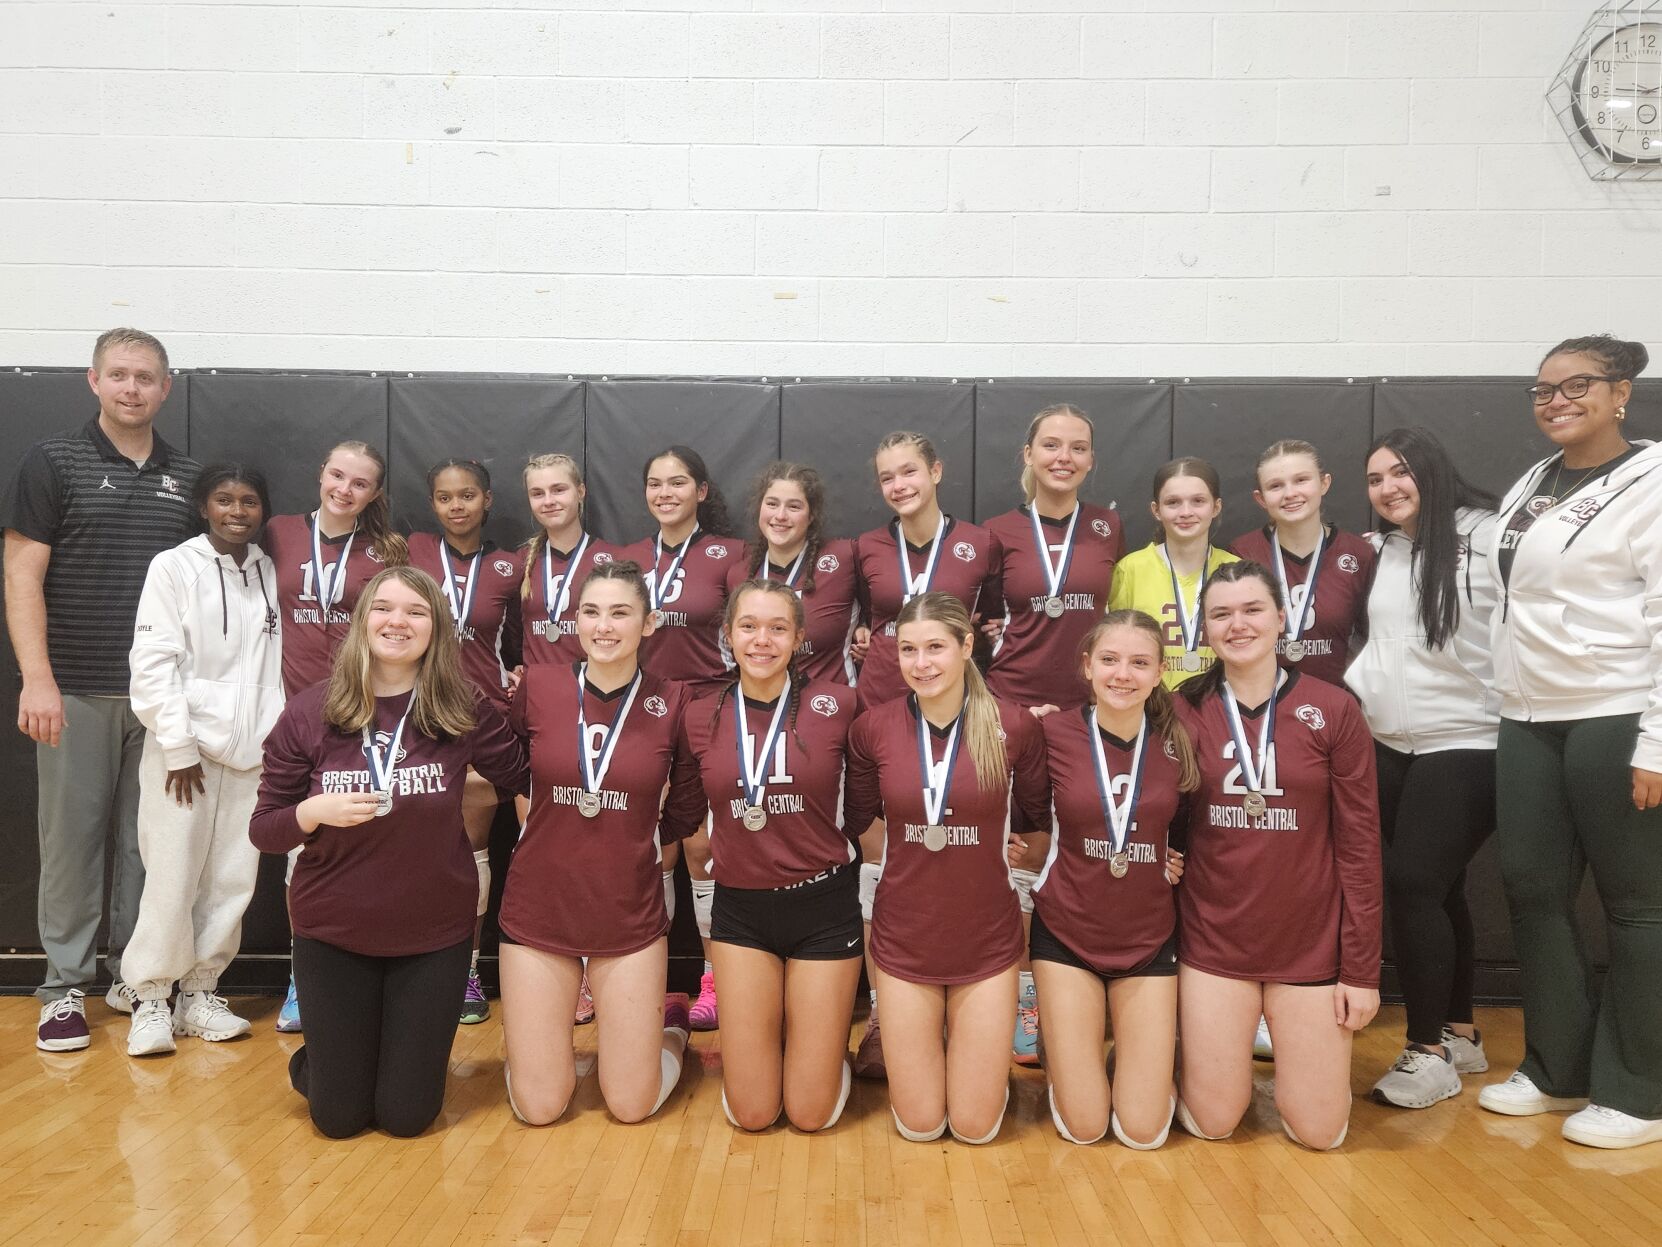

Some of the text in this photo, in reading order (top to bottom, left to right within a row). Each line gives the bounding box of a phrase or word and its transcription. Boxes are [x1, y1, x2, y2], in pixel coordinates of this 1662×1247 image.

[1615, 41, 1629, 53] 11
[1640, 35, 1656, 48] 12
[1594, 61, 1610, 73] 10
[1591, 86, 1600, 98] 9
[1597, 112, 1606, 124] 8
[1617, 129, 1626, 143] 7
[1641, 137, 1650, 150] 6
[161, 475, 179, 493] BC
[1570, 498, 1601, 520] BC
[1064, 594, 1095, 610] CENTRAL
[559, 621, 577, 635] CENT
[1303, 639, 1332, 656] CENTRAL
[390, 763, 445, 783] ENTRAL
[1223, 740, 1284, 796] 21
[768, 794, 805, 814] CENTRAL
[1209, 804, 1251, 829] BRISTOL
[1084, 837, 1114, 861] BRISTO
